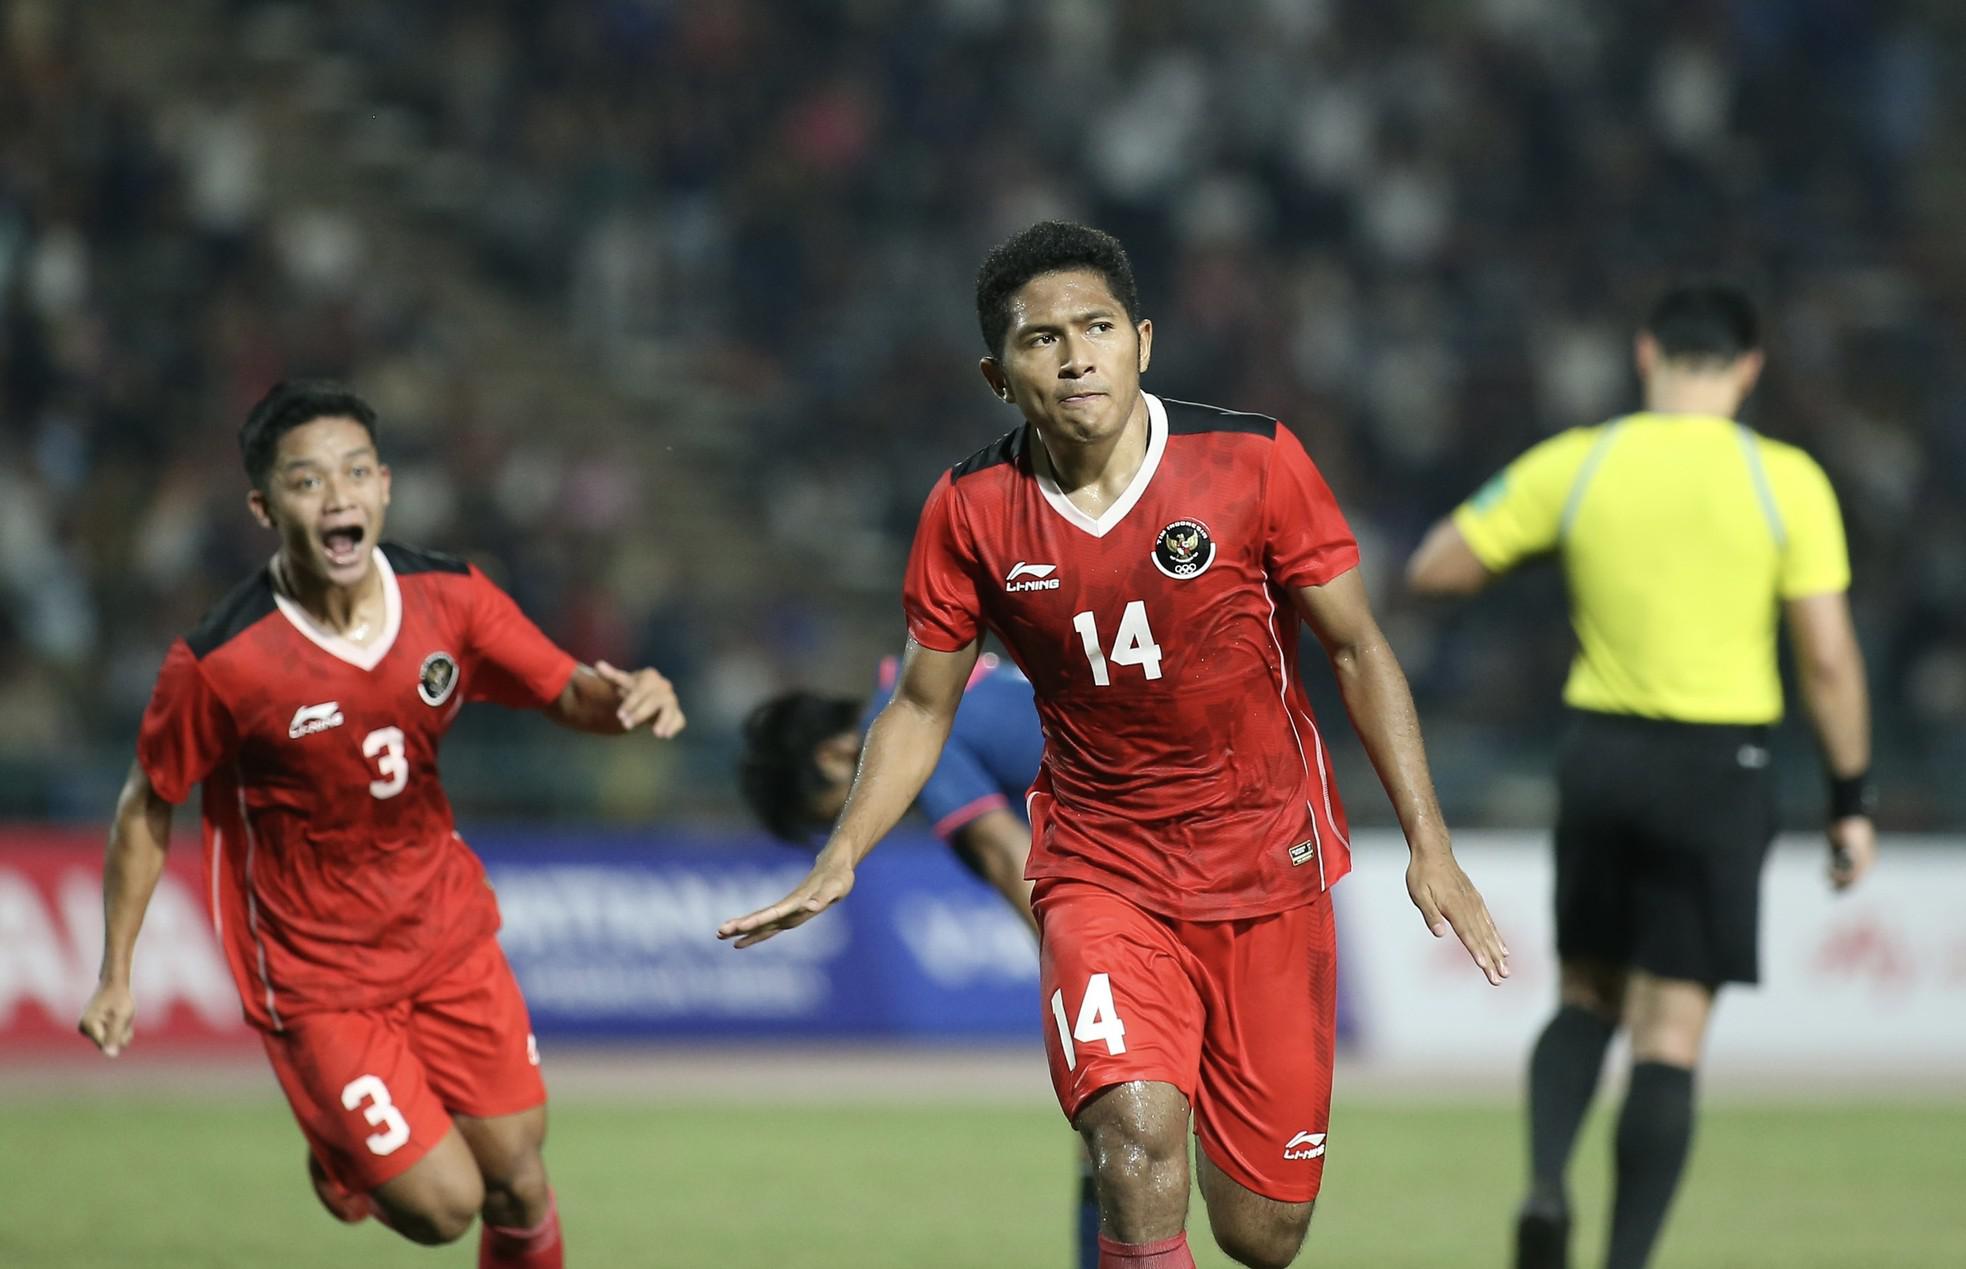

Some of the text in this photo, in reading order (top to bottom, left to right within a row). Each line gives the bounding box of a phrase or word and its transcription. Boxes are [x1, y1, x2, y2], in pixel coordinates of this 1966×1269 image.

[1006, 578, 1060, 592] LI-NING
[1073, 600, 1163, 686] 14
[362, 725, 409, 800] 3
[1050, 972, 1127, 1072] 14
[341, 1074, 411, 1157] 3
